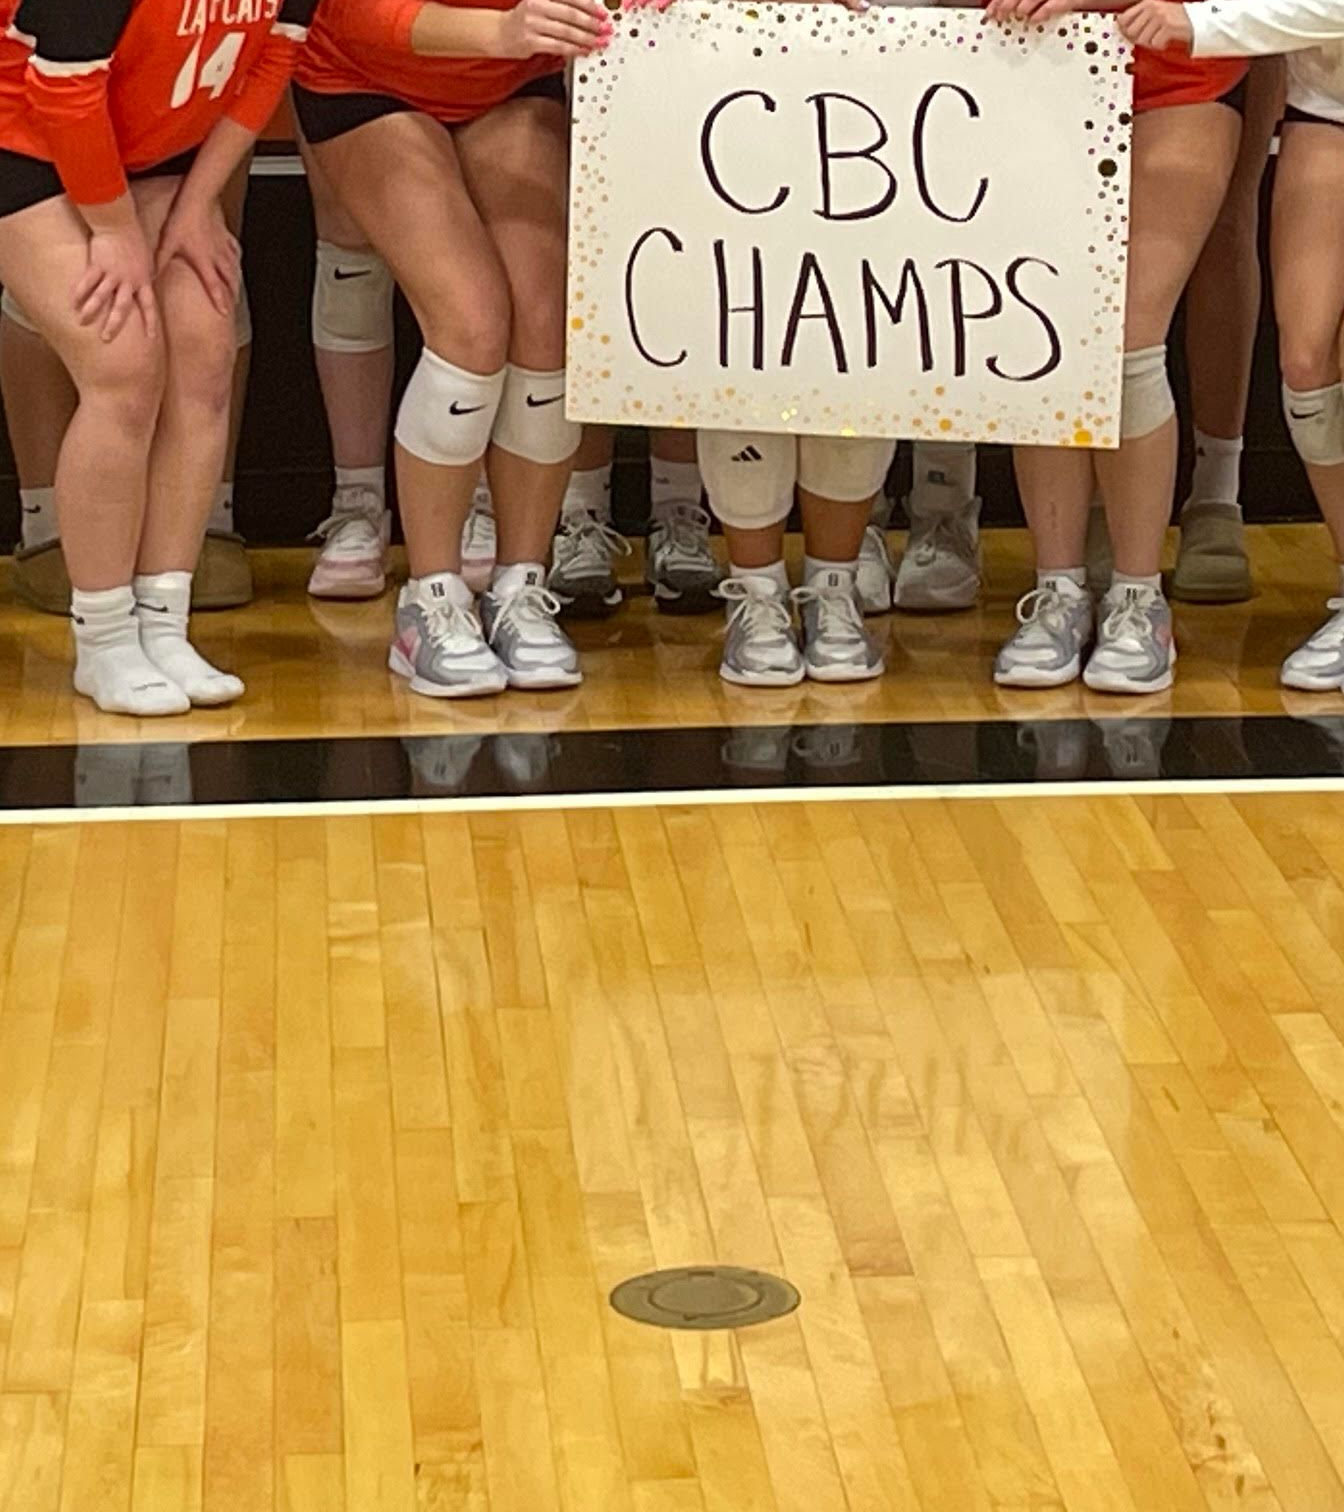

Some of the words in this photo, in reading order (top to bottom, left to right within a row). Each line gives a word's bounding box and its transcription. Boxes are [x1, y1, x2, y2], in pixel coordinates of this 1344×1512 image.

[170, 31, 247, 109] 14
[700, 83, 989, 222] CBC
[624, 227, 1062, 381] CHAMPS
